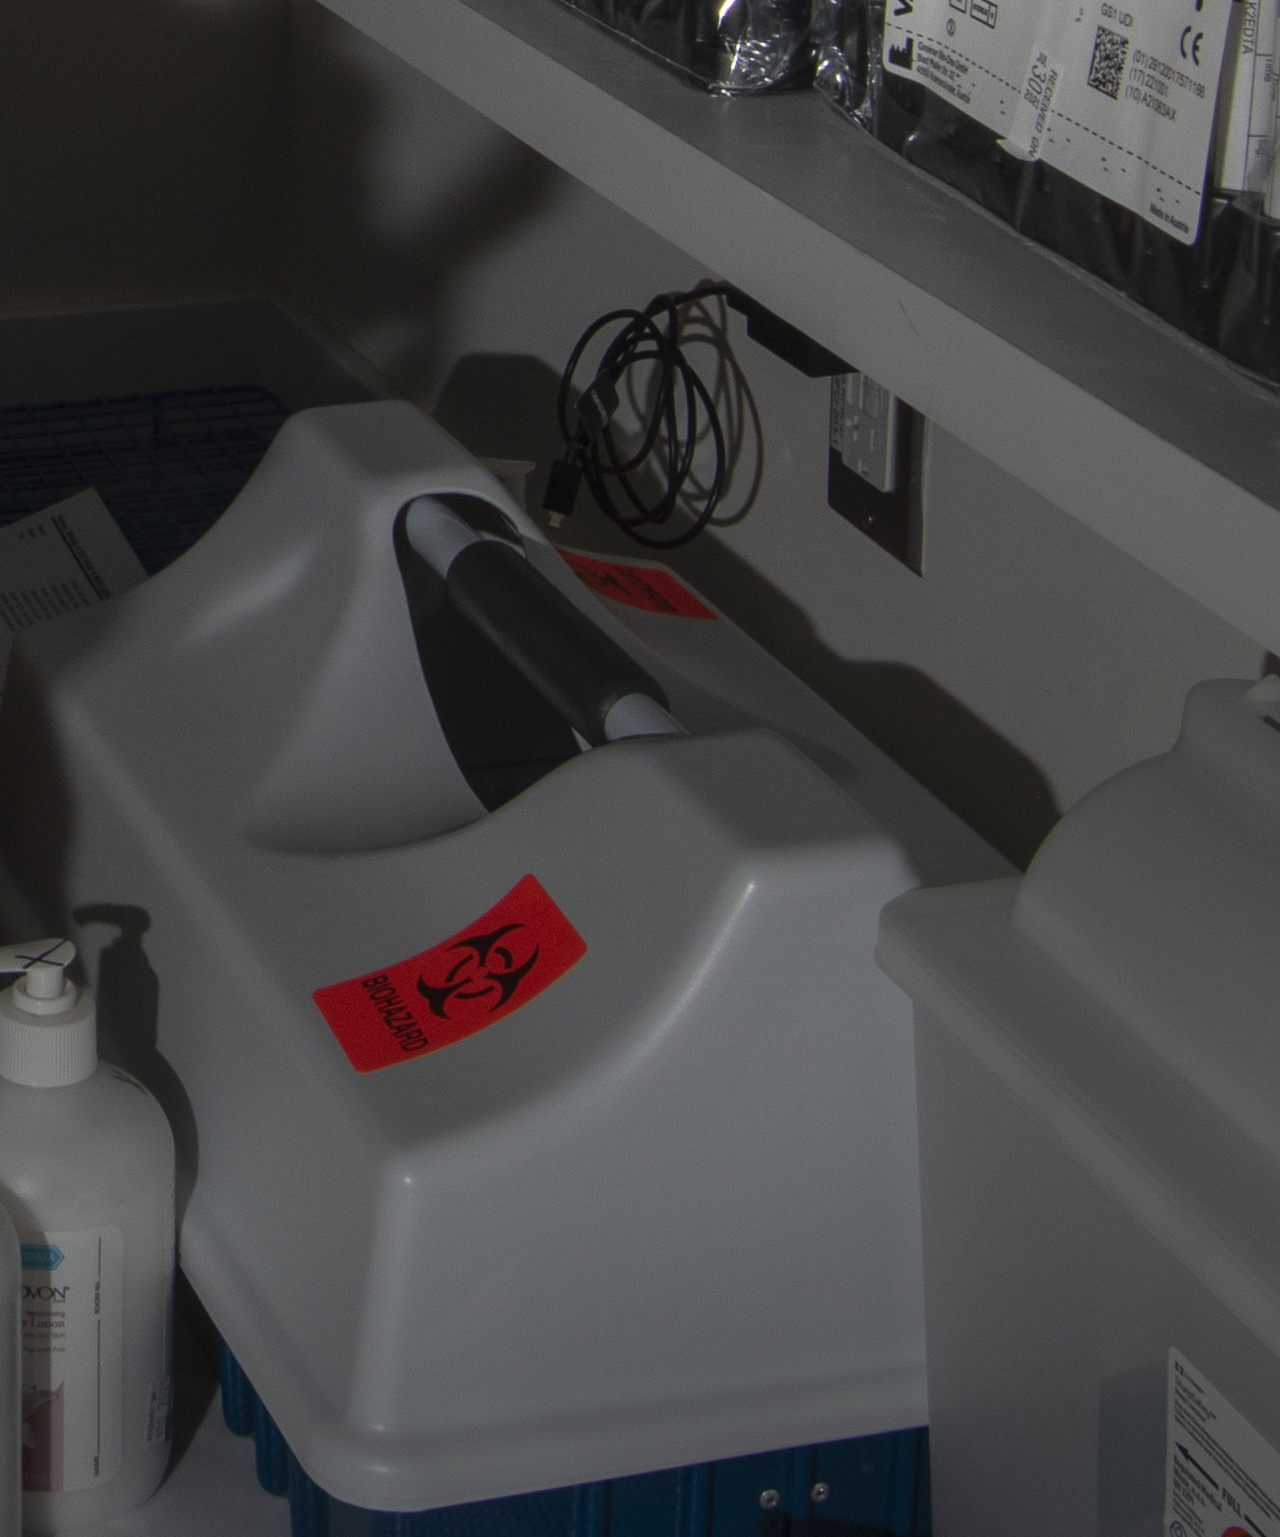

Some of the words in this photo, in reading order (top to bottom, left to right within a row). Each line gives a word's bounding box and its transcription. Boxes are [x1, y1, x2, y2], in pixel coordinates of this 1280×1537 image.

[1241, 1, 1257, 55] K2EDTA
[1029, 136, 1040, 158] ON
[361, 973, 429, 1053] BIOHAZARD
